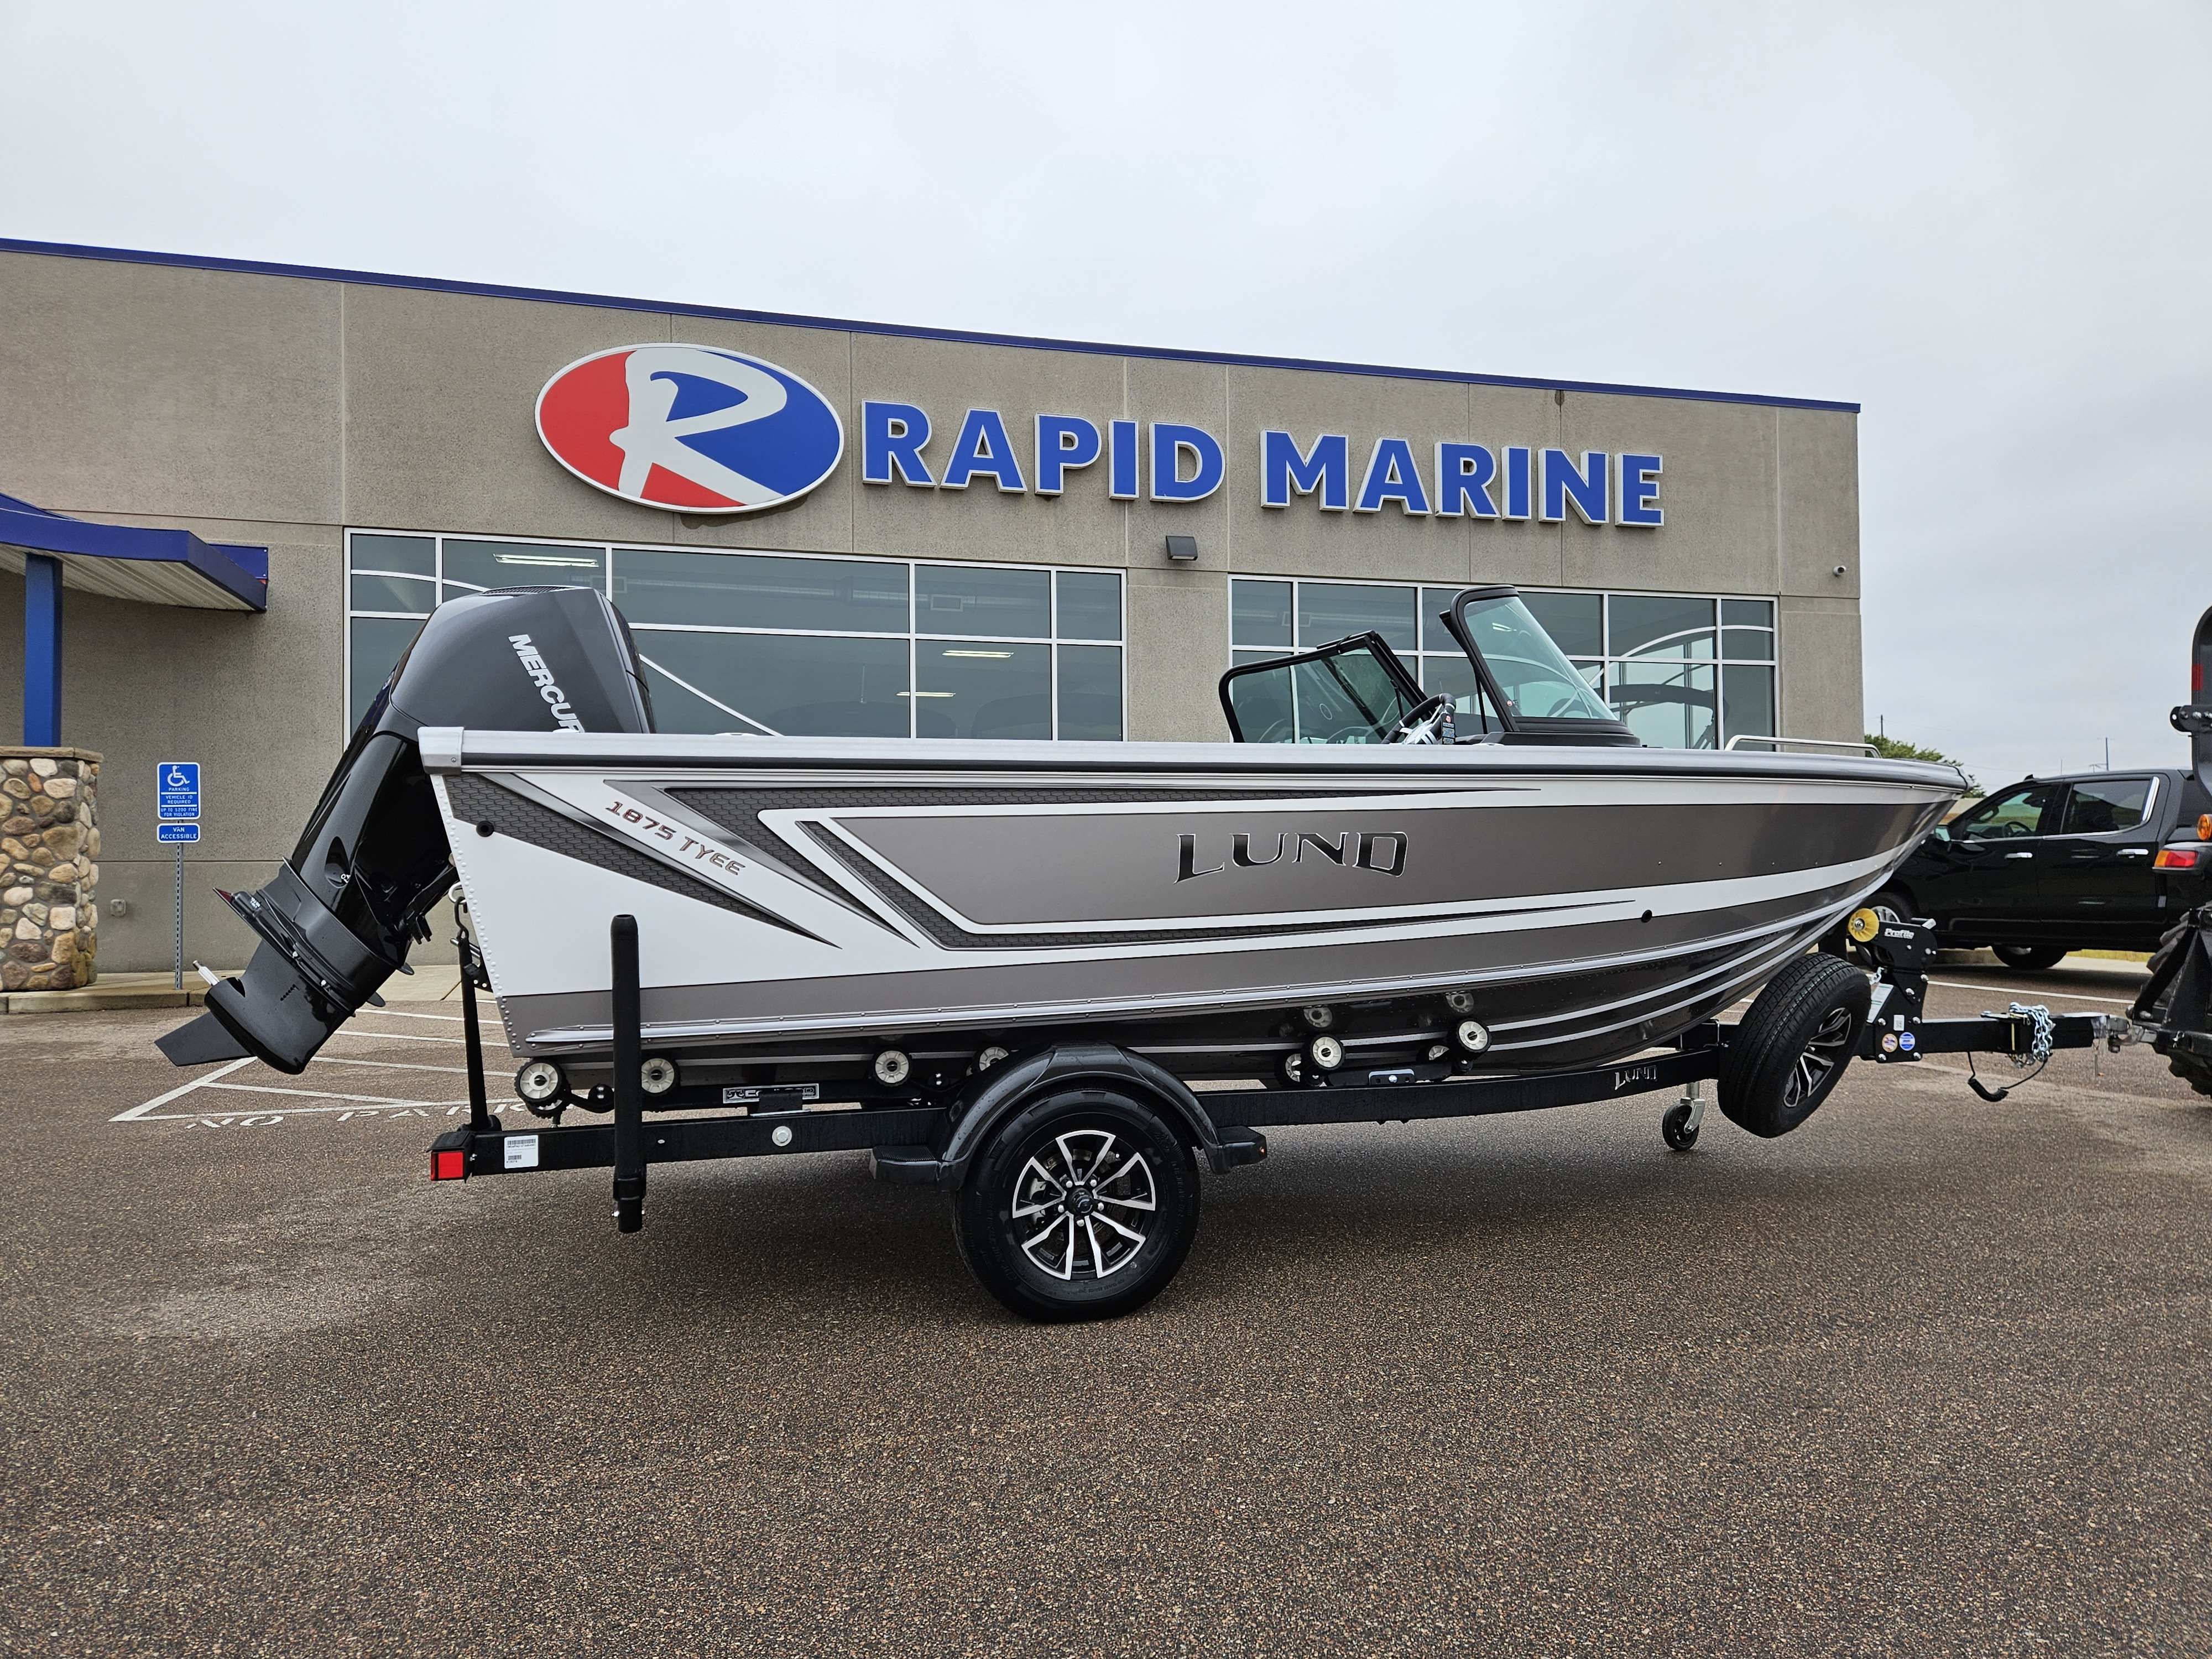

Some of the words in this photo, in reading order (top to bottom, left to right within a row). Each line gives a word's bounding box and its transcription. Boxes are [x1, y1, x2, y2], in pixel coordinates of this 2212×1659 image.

[860, 399, 1225, 503] RAPID
[1260, 429, 1664, 526] MARINE
[508, 634, 585, 733] MERCUR
[605, 801, 676, 840] 1875
[679, 836, 745, 875] TYEE
[1173, 831, 1408, 885] LUND
[185, 1116, 284, 1129] NO
[336, 1103, 574, 1122] PARK
